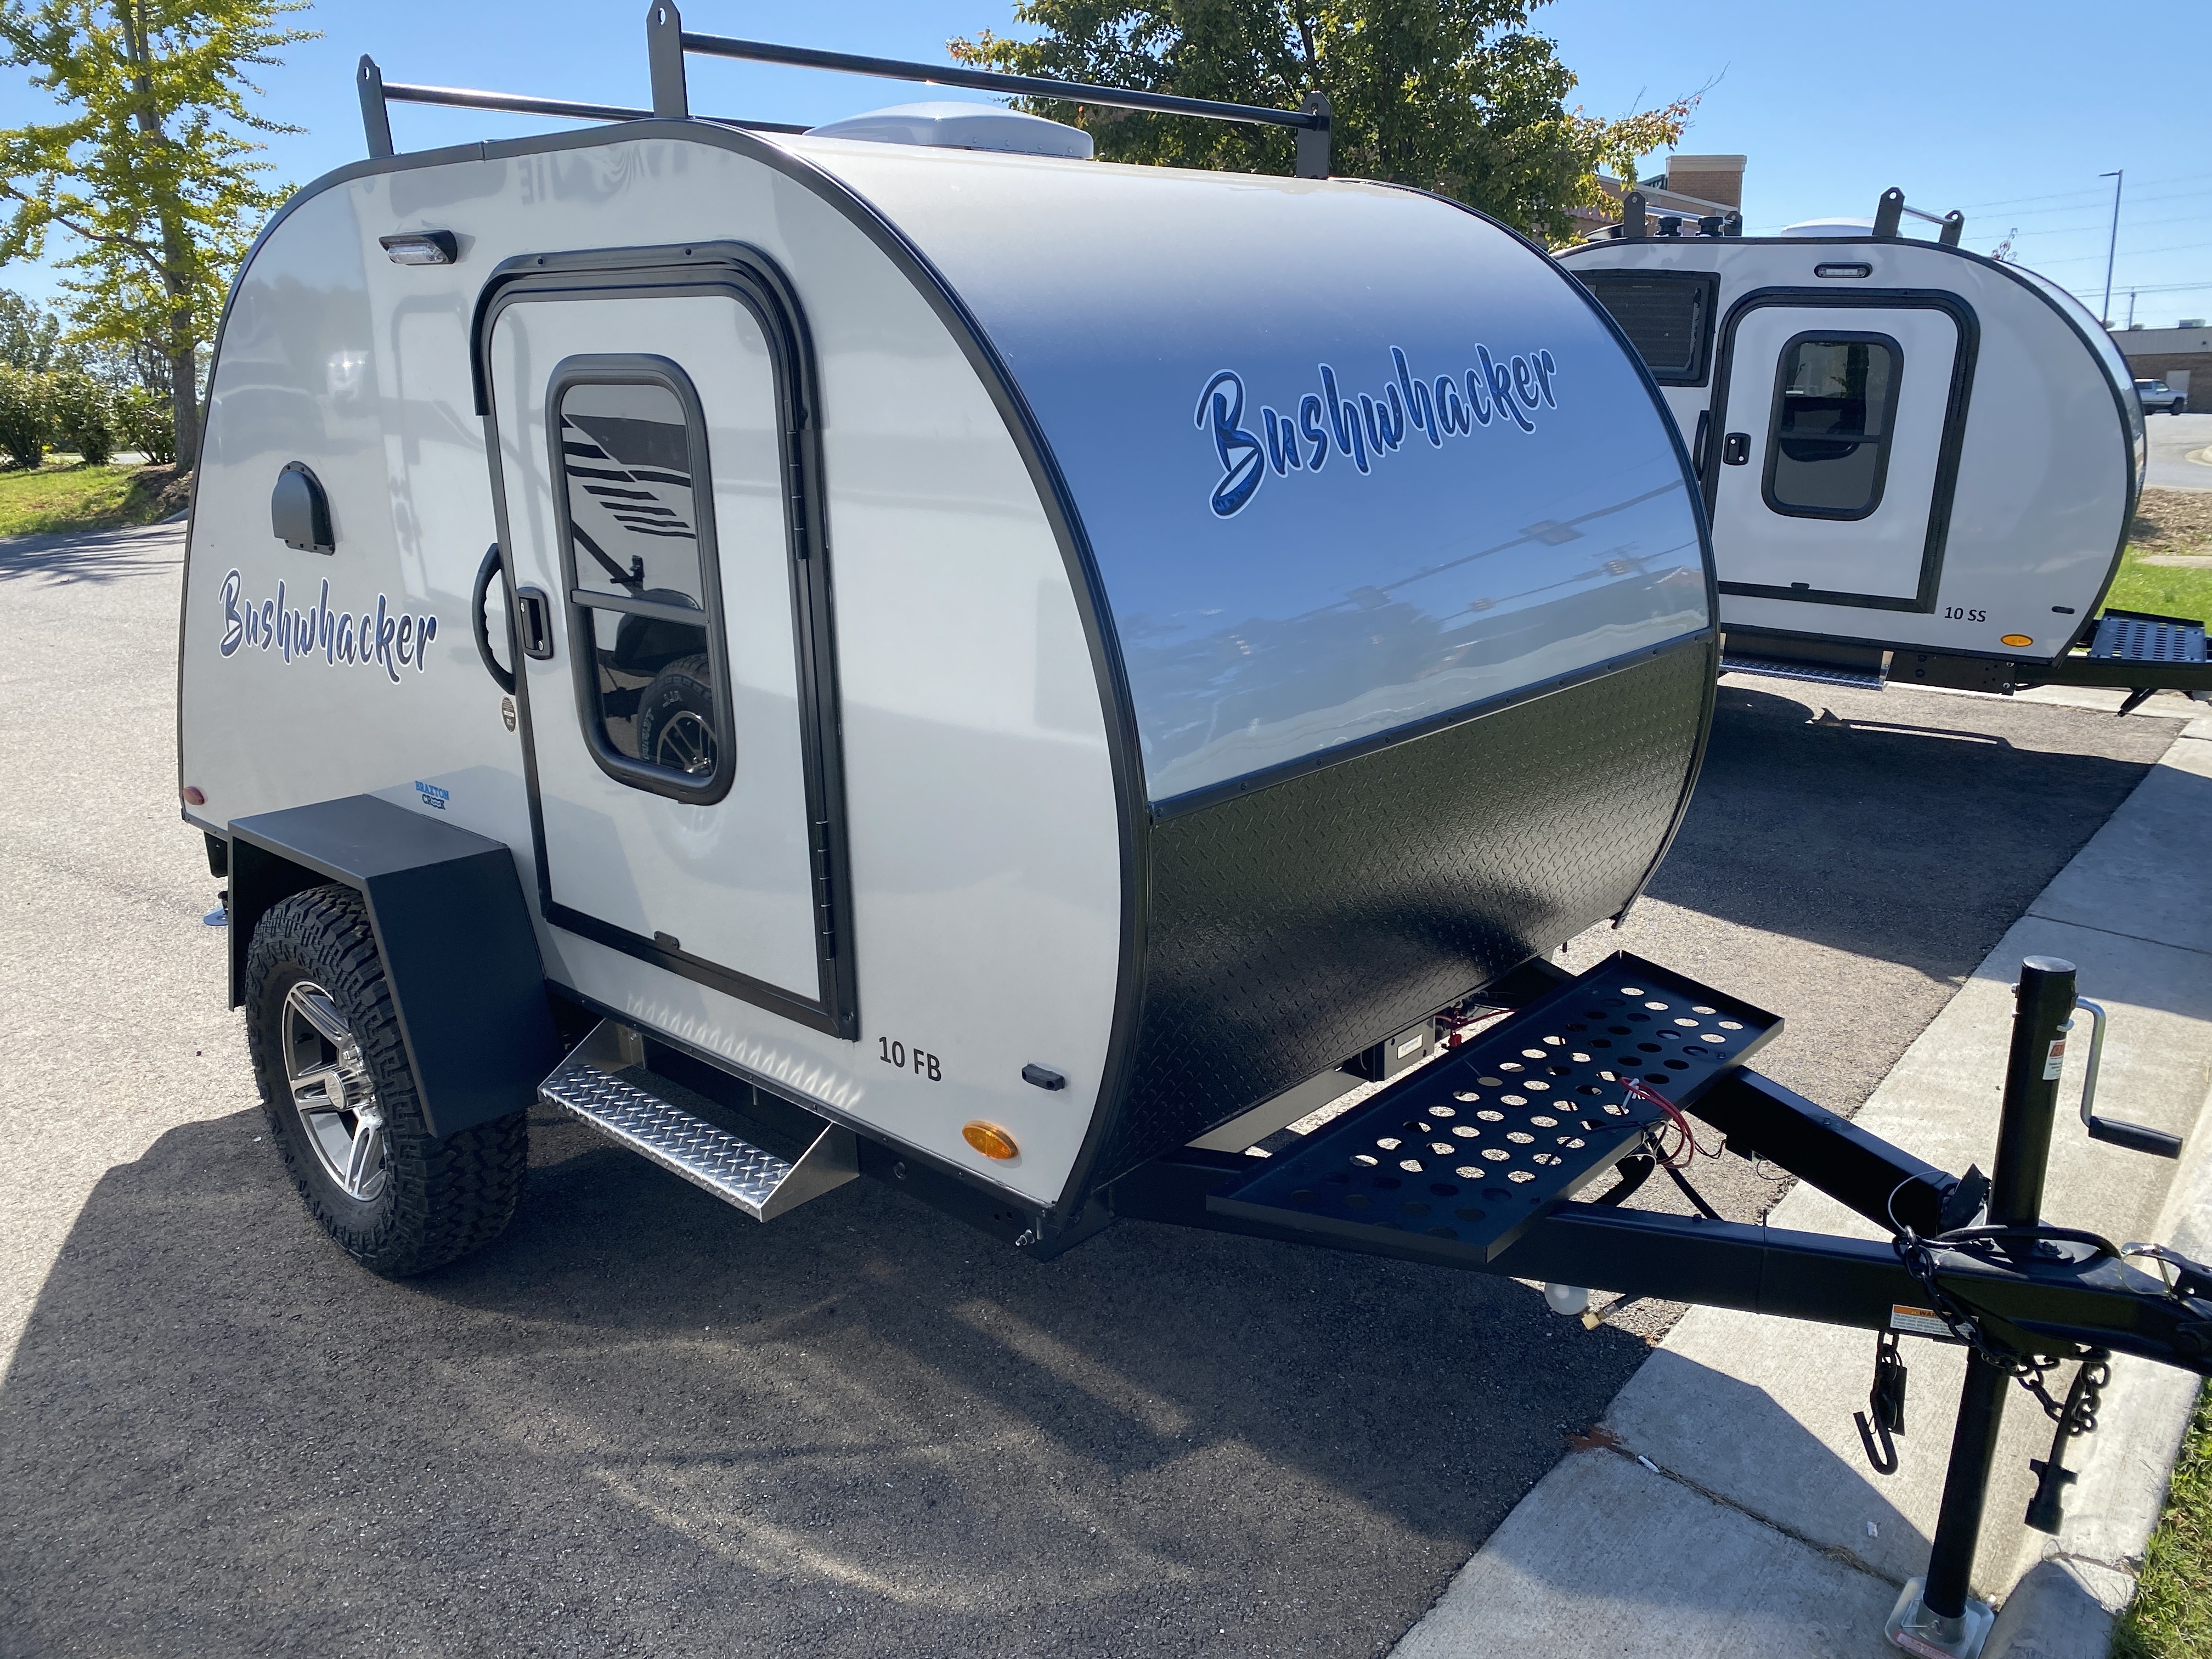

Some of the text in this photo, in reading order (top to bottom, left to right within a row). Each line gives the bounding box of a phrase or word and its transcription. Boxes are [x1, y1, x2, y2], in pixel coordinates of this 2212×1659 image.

[1194, 343, 1557, 519] Bushwhacker
[219, 568, 437, 684] Bushwhacker
[1944, 607, 1987, 622] 10 SS
[415, 780, 449, 801] BRAXTON
[879, 1036, 941, 1082] 10 FB
